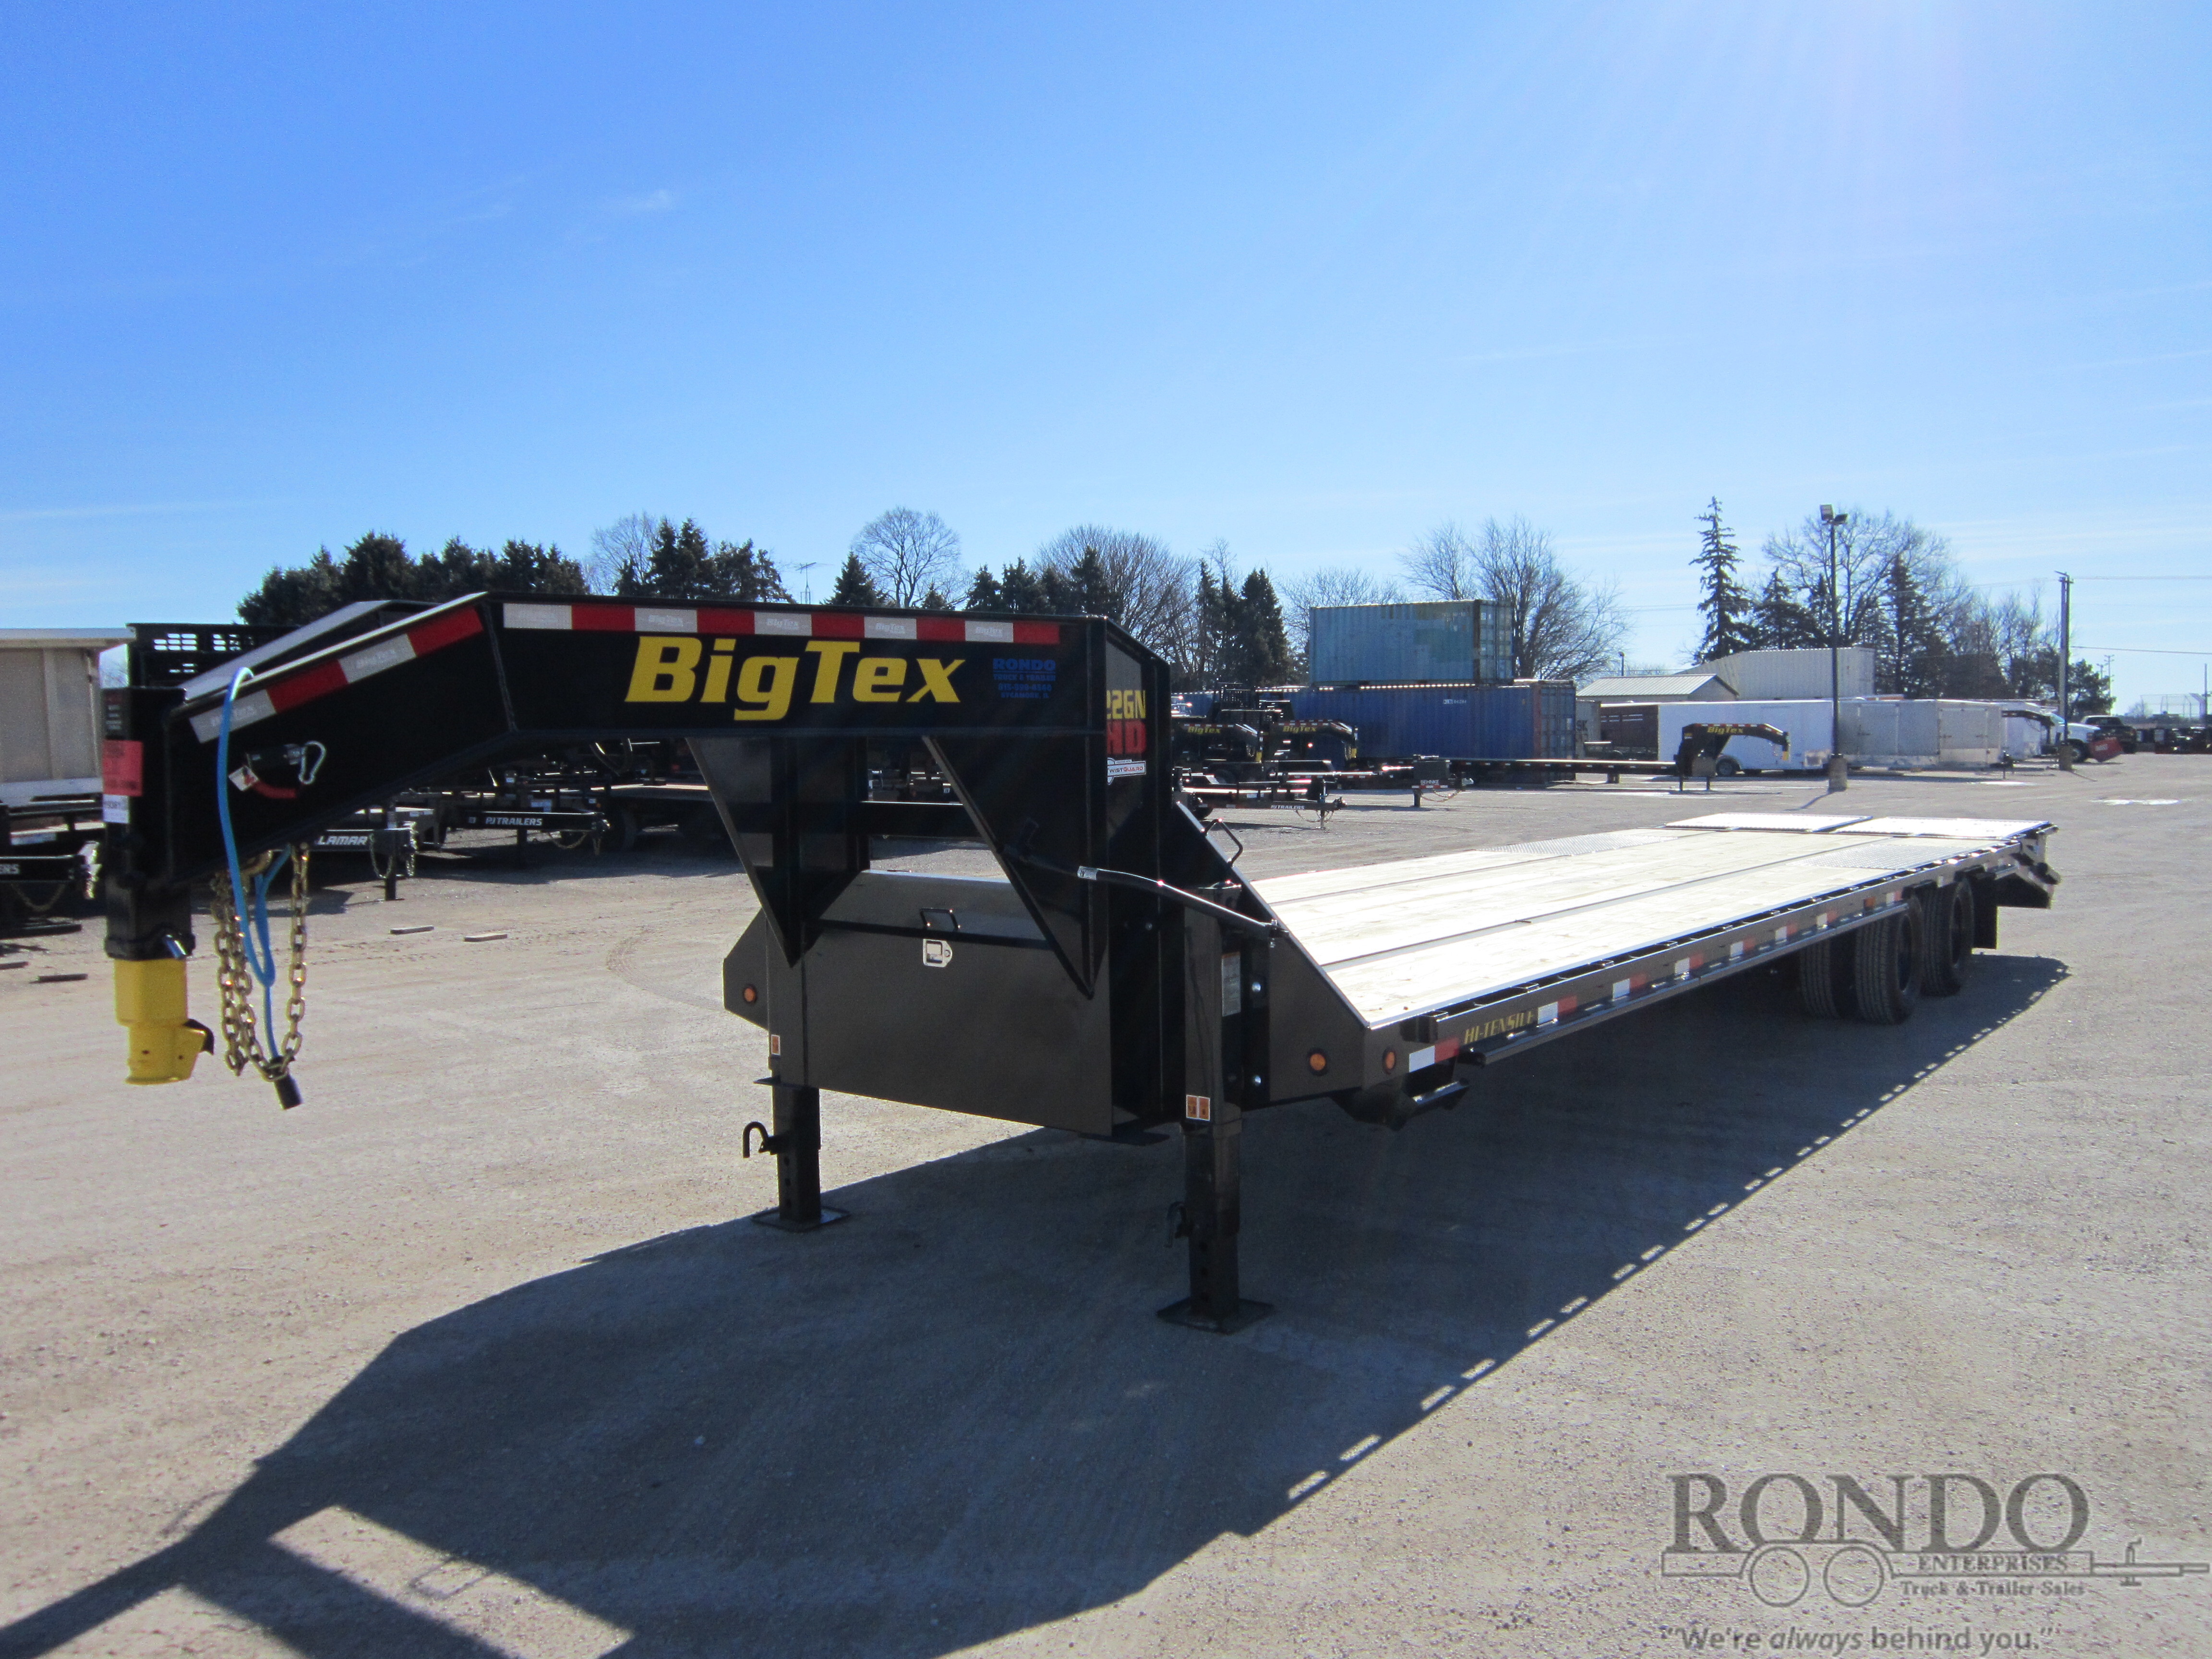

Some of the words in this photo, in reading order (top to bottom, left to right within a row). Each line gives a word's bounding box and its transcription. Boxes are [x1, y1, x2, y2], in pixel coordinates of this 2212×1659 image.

[993, 658, 1056, 671] RONDO
[625, 636, 966, 721] BigTex
[1188, 726, 1221, 734] BigTex
[1707, 726, 1744, 734] BigTex
[1106, 721, 1146, 755] HD
[317, 835, 368, 846] LAMAR
